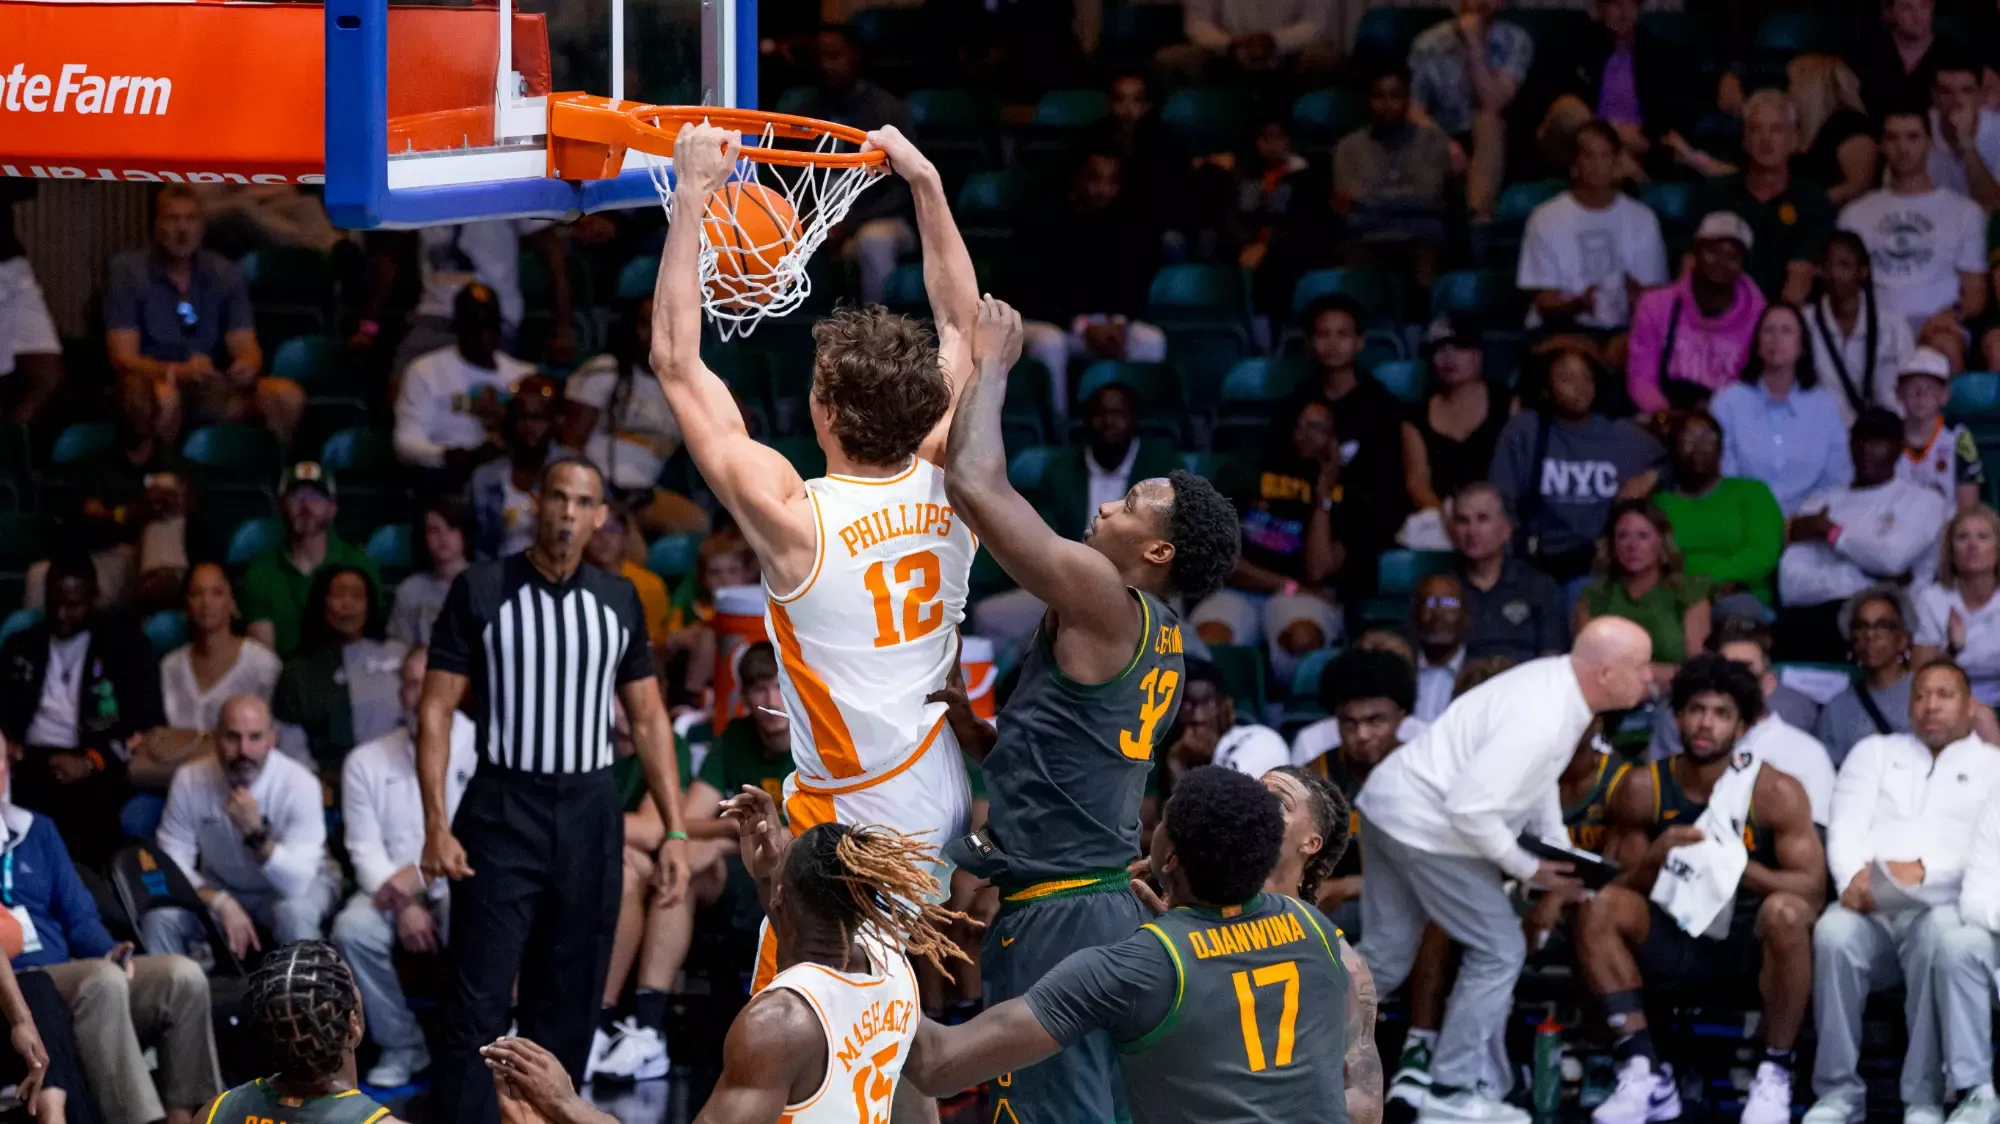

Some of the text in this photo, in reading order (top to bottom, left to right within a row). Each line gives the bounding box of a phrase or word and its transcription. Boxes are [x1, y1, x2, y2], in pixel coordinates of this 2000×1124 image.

[1540, 459, 1618, 498] NYC
[838, 503, 954, 558] PHILLIPS
[863, 549, 944, 648] 12
[1119, 667, 1179, 760] 32
[1231, 960, 1300, 1072] 17
[852, 1041, 899, 1124] 15
